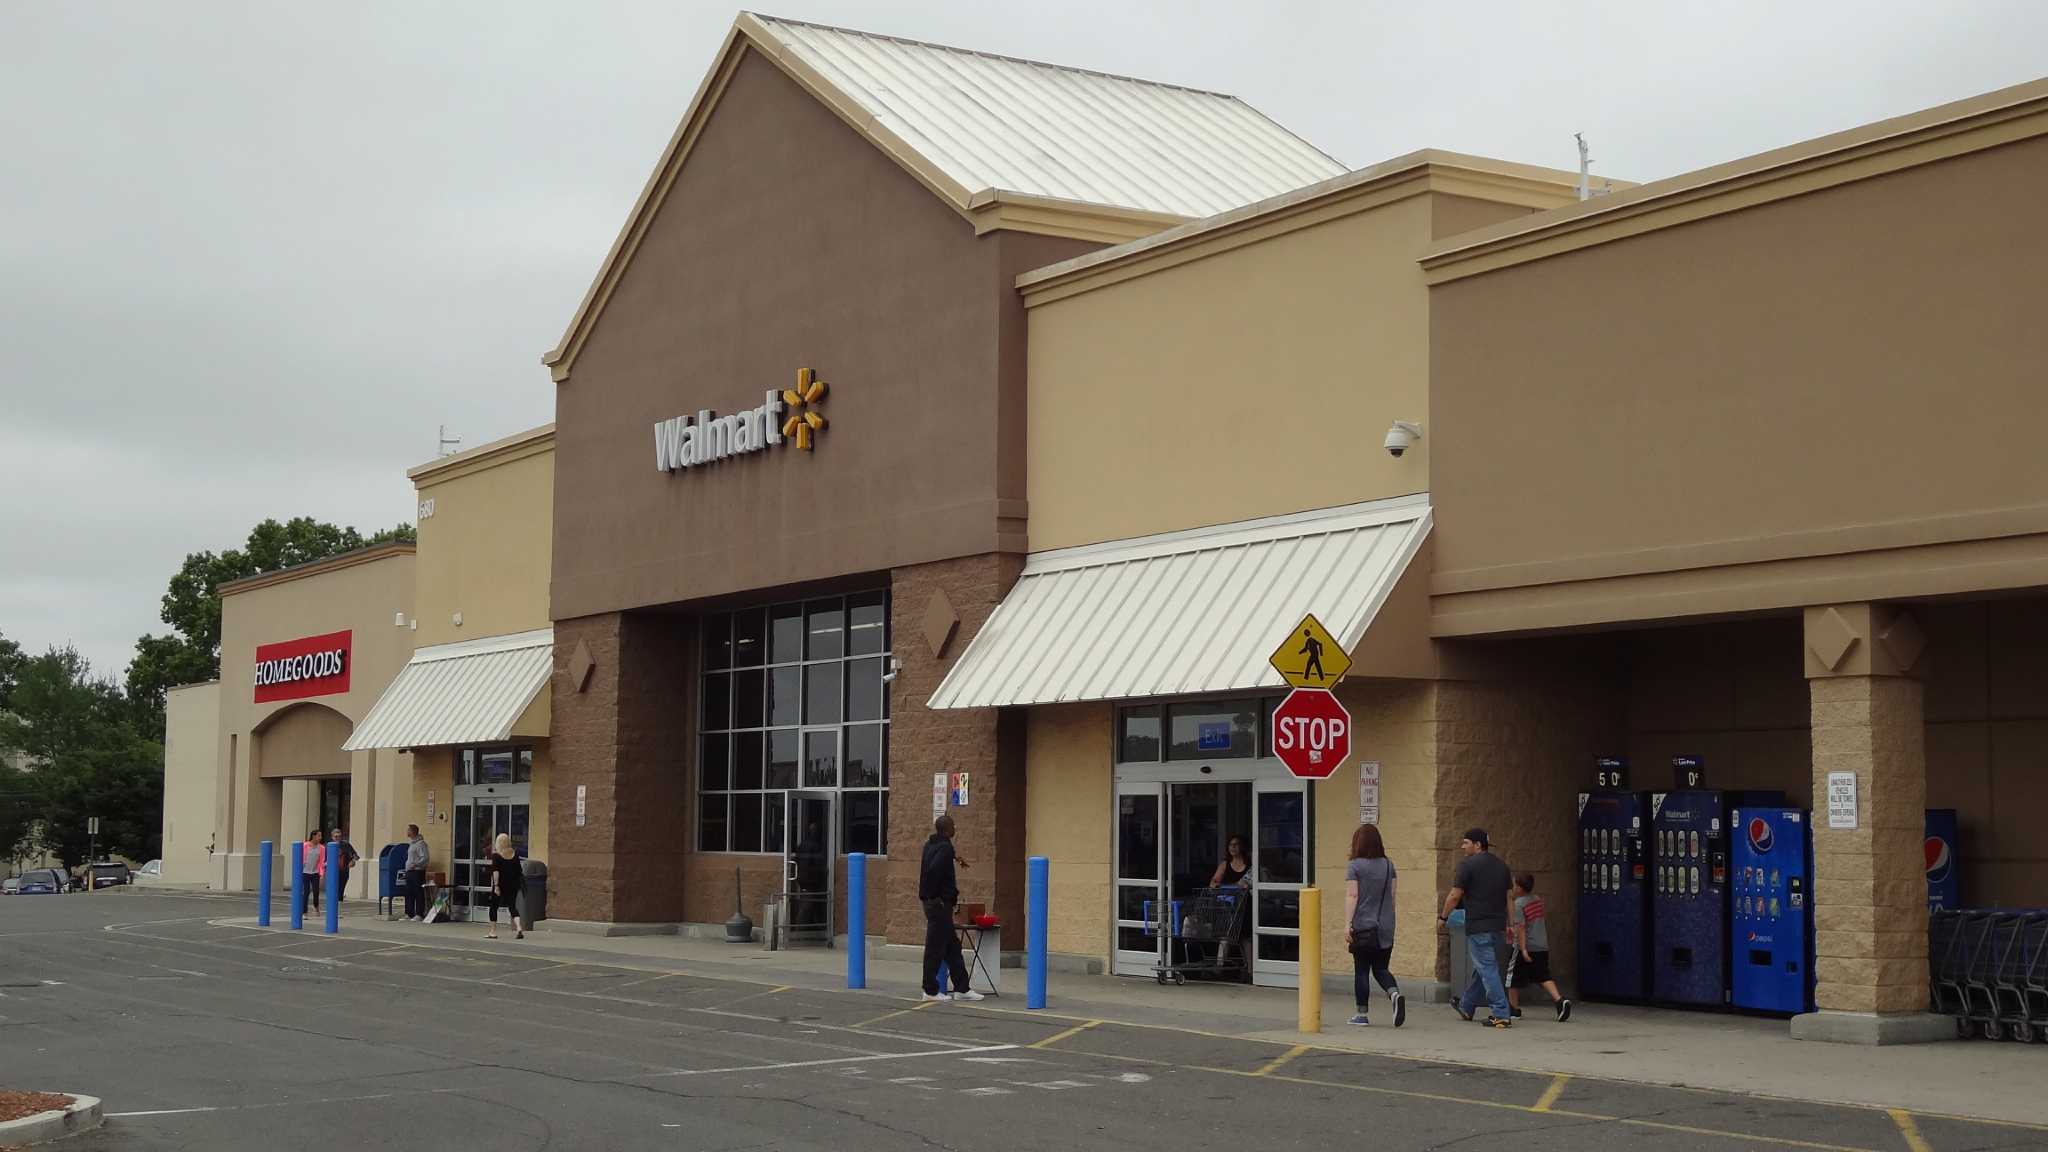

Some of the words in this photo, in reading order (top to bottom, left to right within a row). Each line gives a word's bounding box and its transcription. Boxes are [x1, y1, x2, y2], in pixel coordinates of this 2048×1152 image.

[654, 389, 783, 472] Walmart
[254, 648, 343, 686] HOMEGOODS
[1278, 716, 1345, 750] STOP
